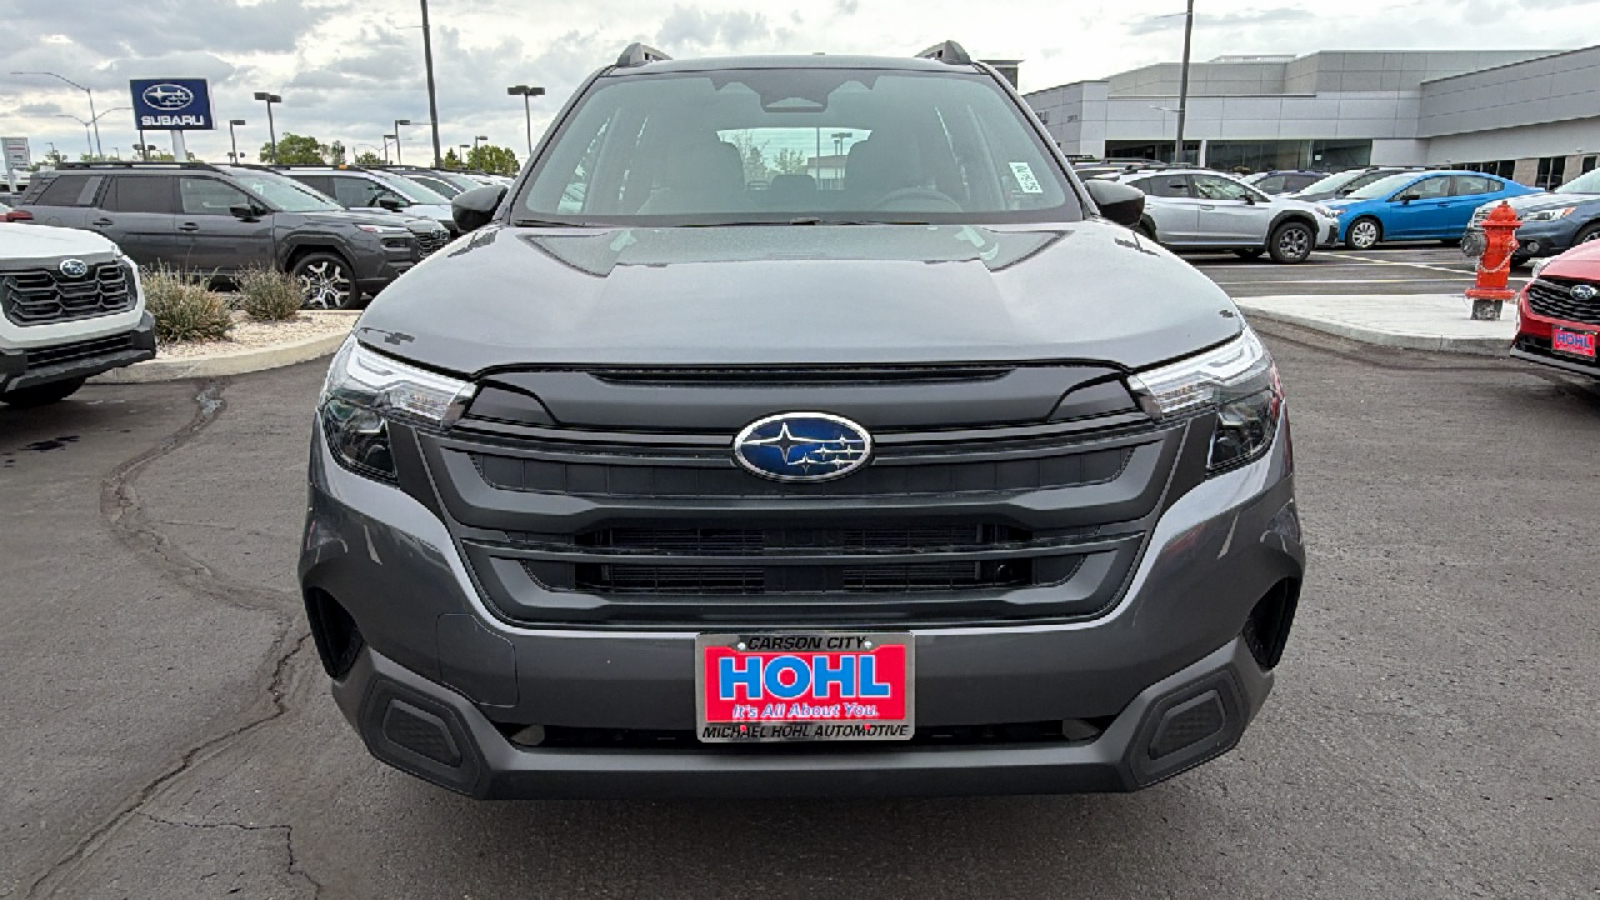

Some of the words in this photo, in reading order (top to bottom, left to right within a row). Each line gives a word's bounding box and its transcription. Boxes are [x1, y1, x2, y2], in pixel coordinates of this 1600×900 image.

[141, 115, 204, 126] SUBARU
[1556, 332, 1590, 348] HOHL
[749, 636, 822, 650] CARSON
[827, 635, 866, 649] CITY
[718, 655, 891, 701] HOHL
[732, 704, 759, 719] It's
[761, 703, 786, 718] All
[787, 702, 841, 718] About
[842, 702, 880, 718] You.
[702, 725, 767, 738] MICHAEL
[770, 725, 810, 738] HOHL
[813, 724, 910, 737] AUTOMOTIVE
